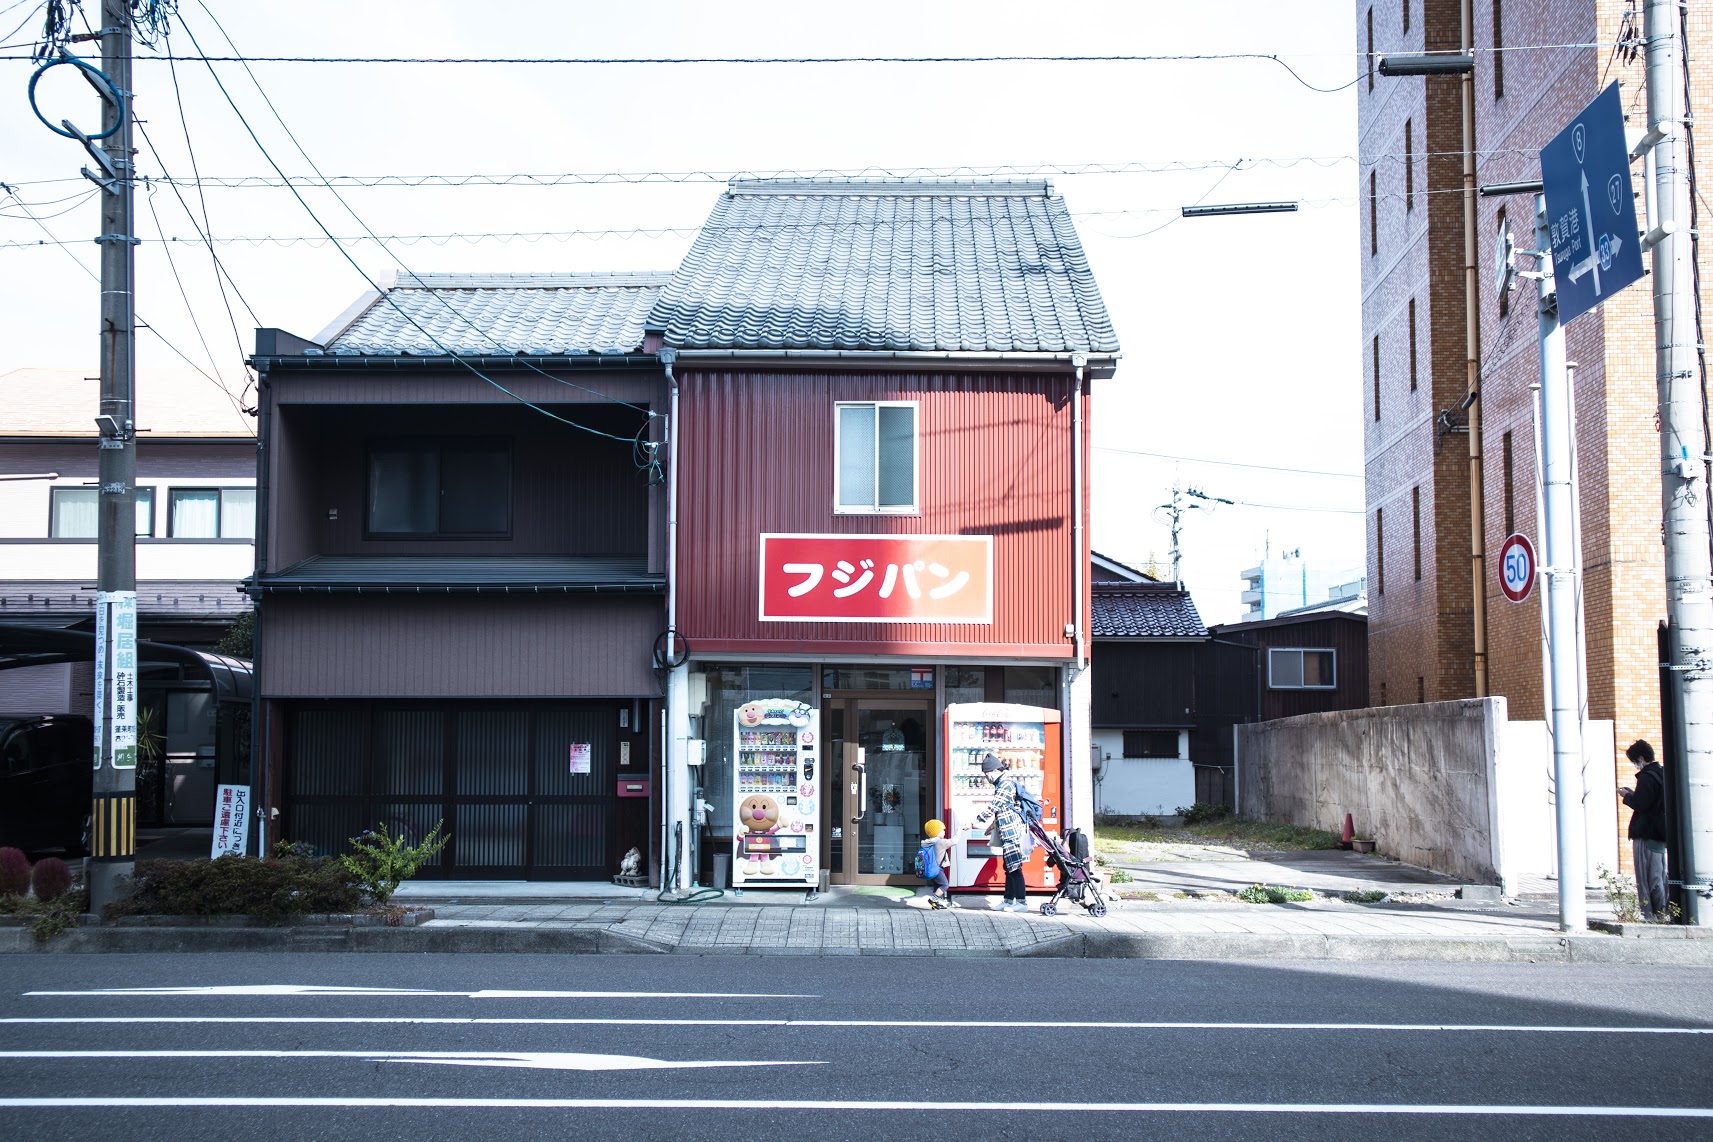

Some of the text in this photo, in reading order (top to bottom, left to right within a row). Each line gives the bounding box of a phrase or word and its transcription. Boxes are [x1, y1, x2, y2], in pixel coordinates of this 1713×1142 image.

[1575, 131, 1582, 151] 8
[1611, 181, 1620, 204] 27
[1551, 207, 1580, 249] 敦賀港
[1553, 235, 1582, 266] Tsuruga Port
[1600, 244, 1610, 262] 33
[783, 558, 970, 599] フジパン
[1506, 553, 1527, 583] 50
[126, 672, 134, 702] 土木工事
[217, 788, 233, 849] 駐車ご遠慮下さい
[231, 789, 246, 851] 出入口付近につき
